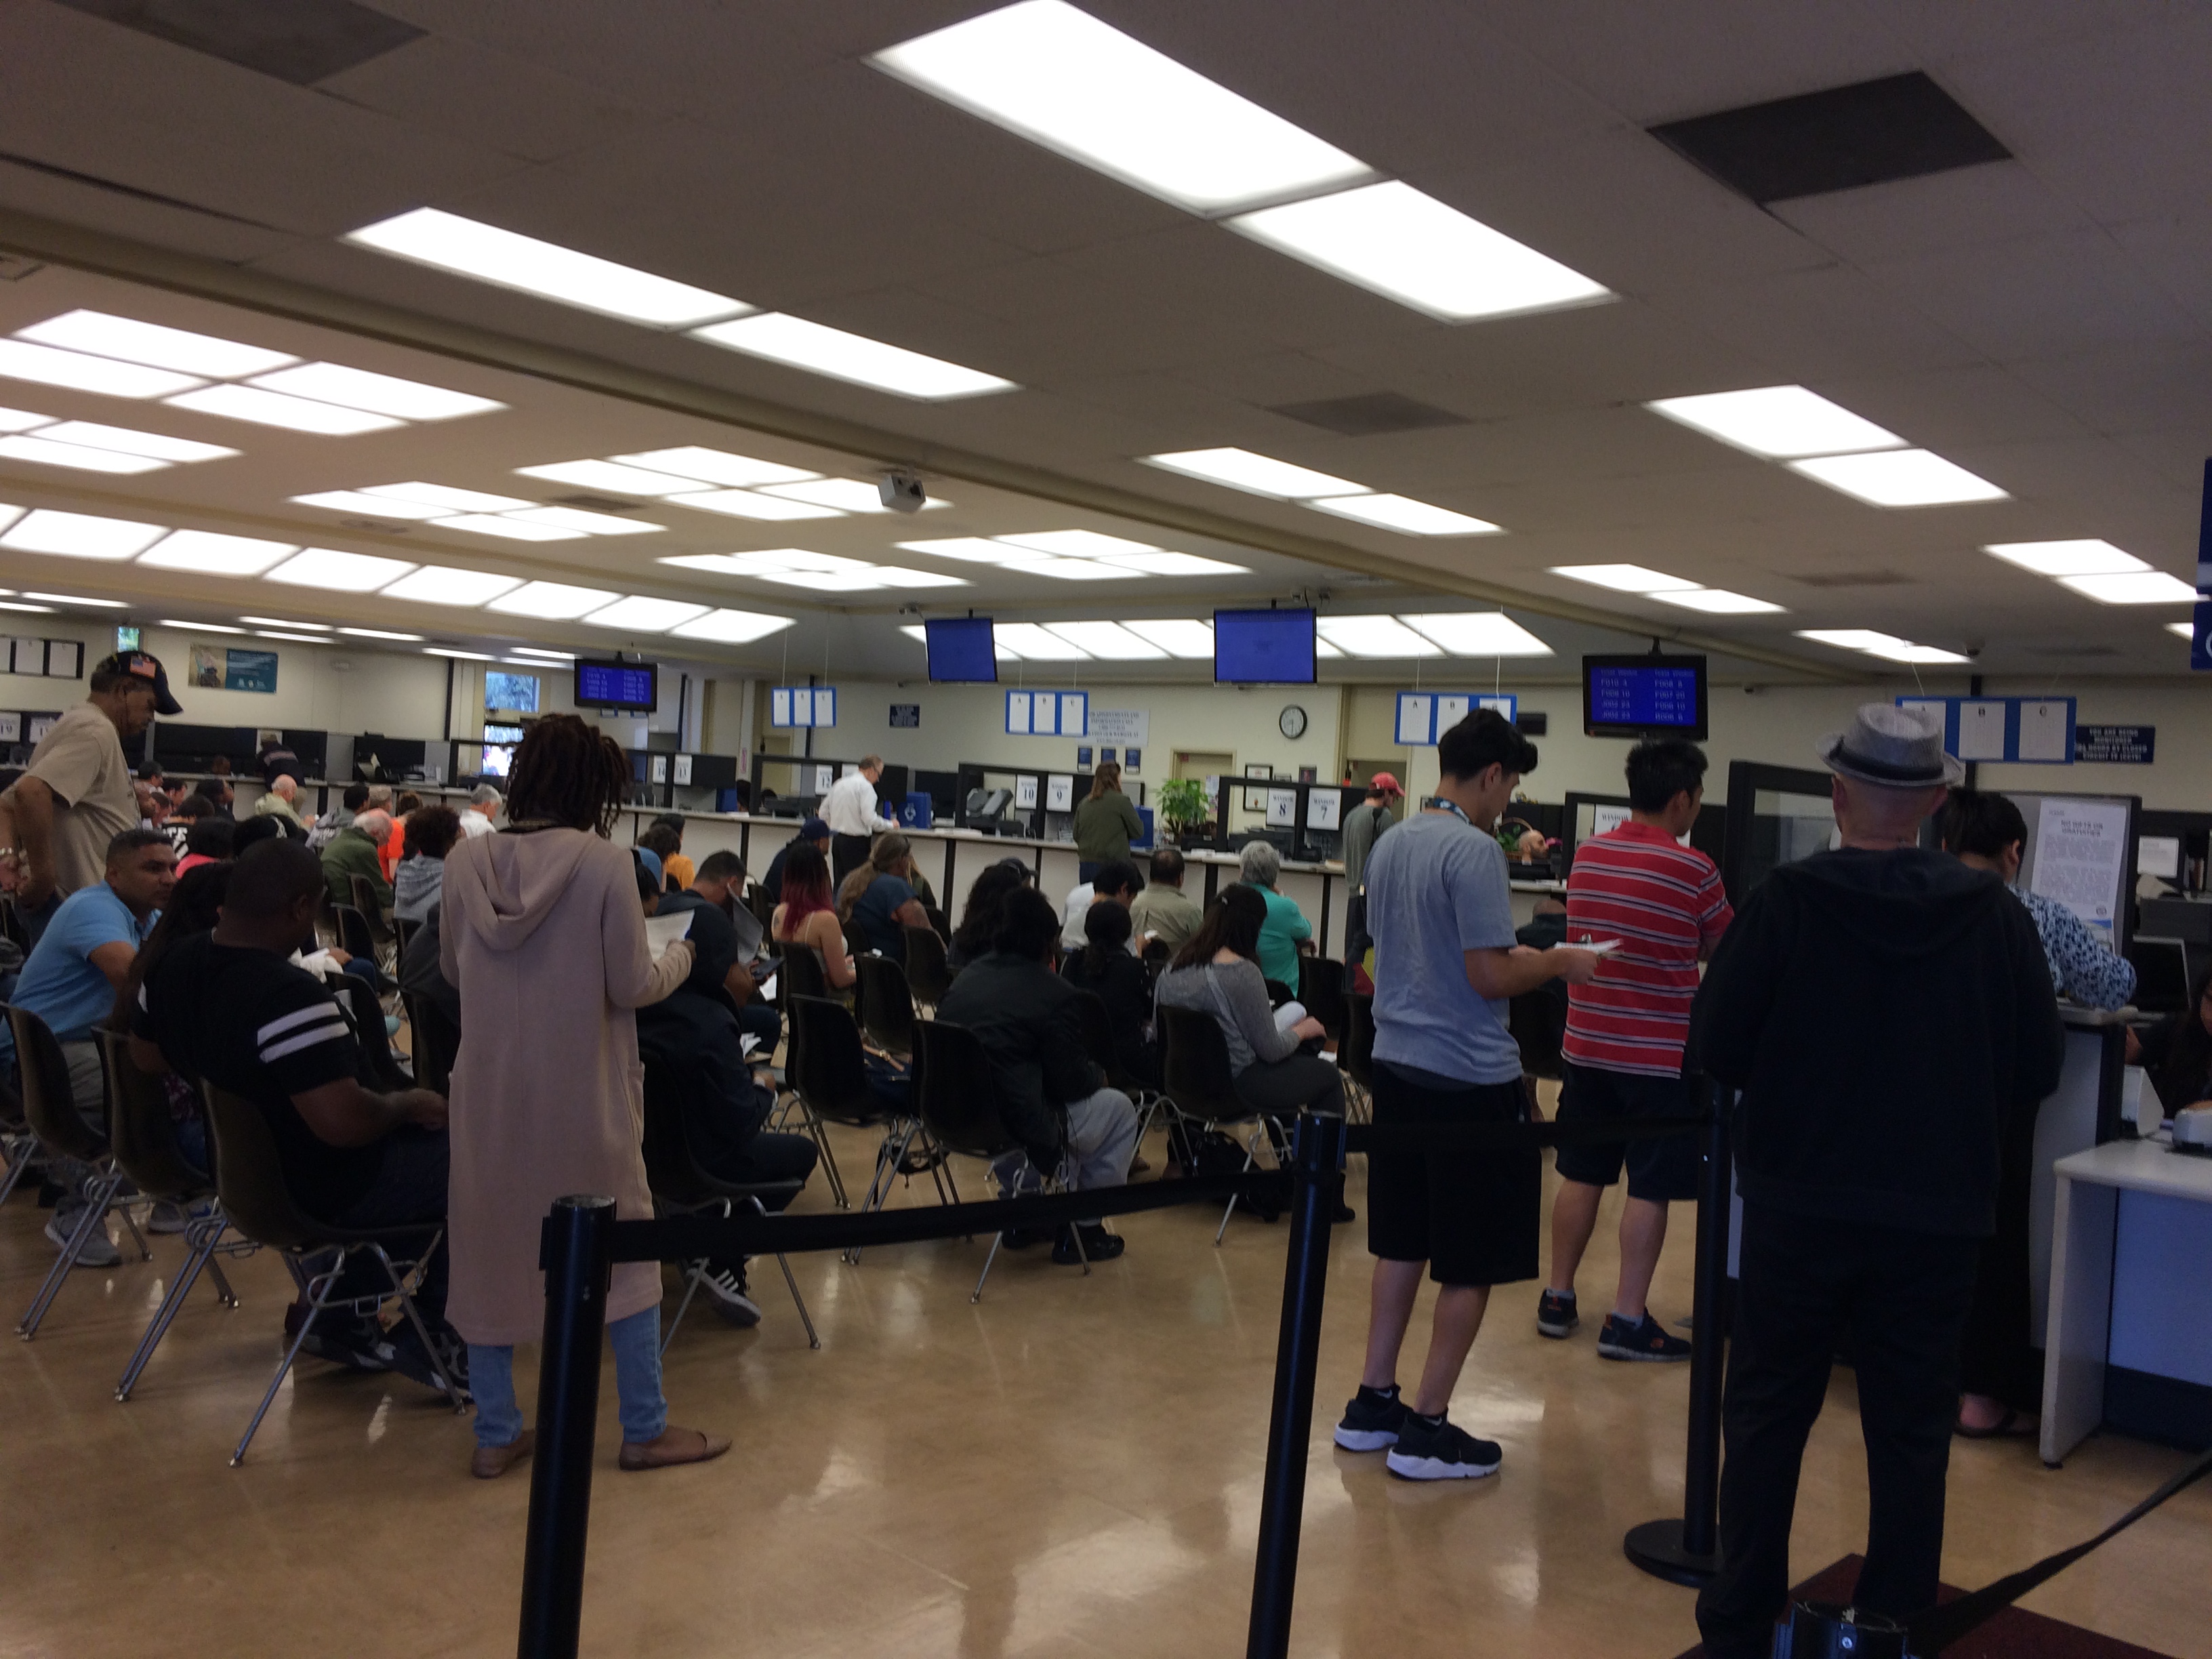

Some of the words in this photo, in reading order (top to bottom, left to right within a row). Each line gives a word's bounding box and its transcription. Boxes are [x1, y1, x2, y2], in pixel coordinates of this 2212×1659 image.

[1412, 699, 1418, 709] A
[1450, 700, 1455, 710] B
[1024, 788, 1034, 800] 10
[1057, 790, 1063, 802] 9
[1279, 802, 1286, 817] 8
[1320, 804, 1328, 821] 7
